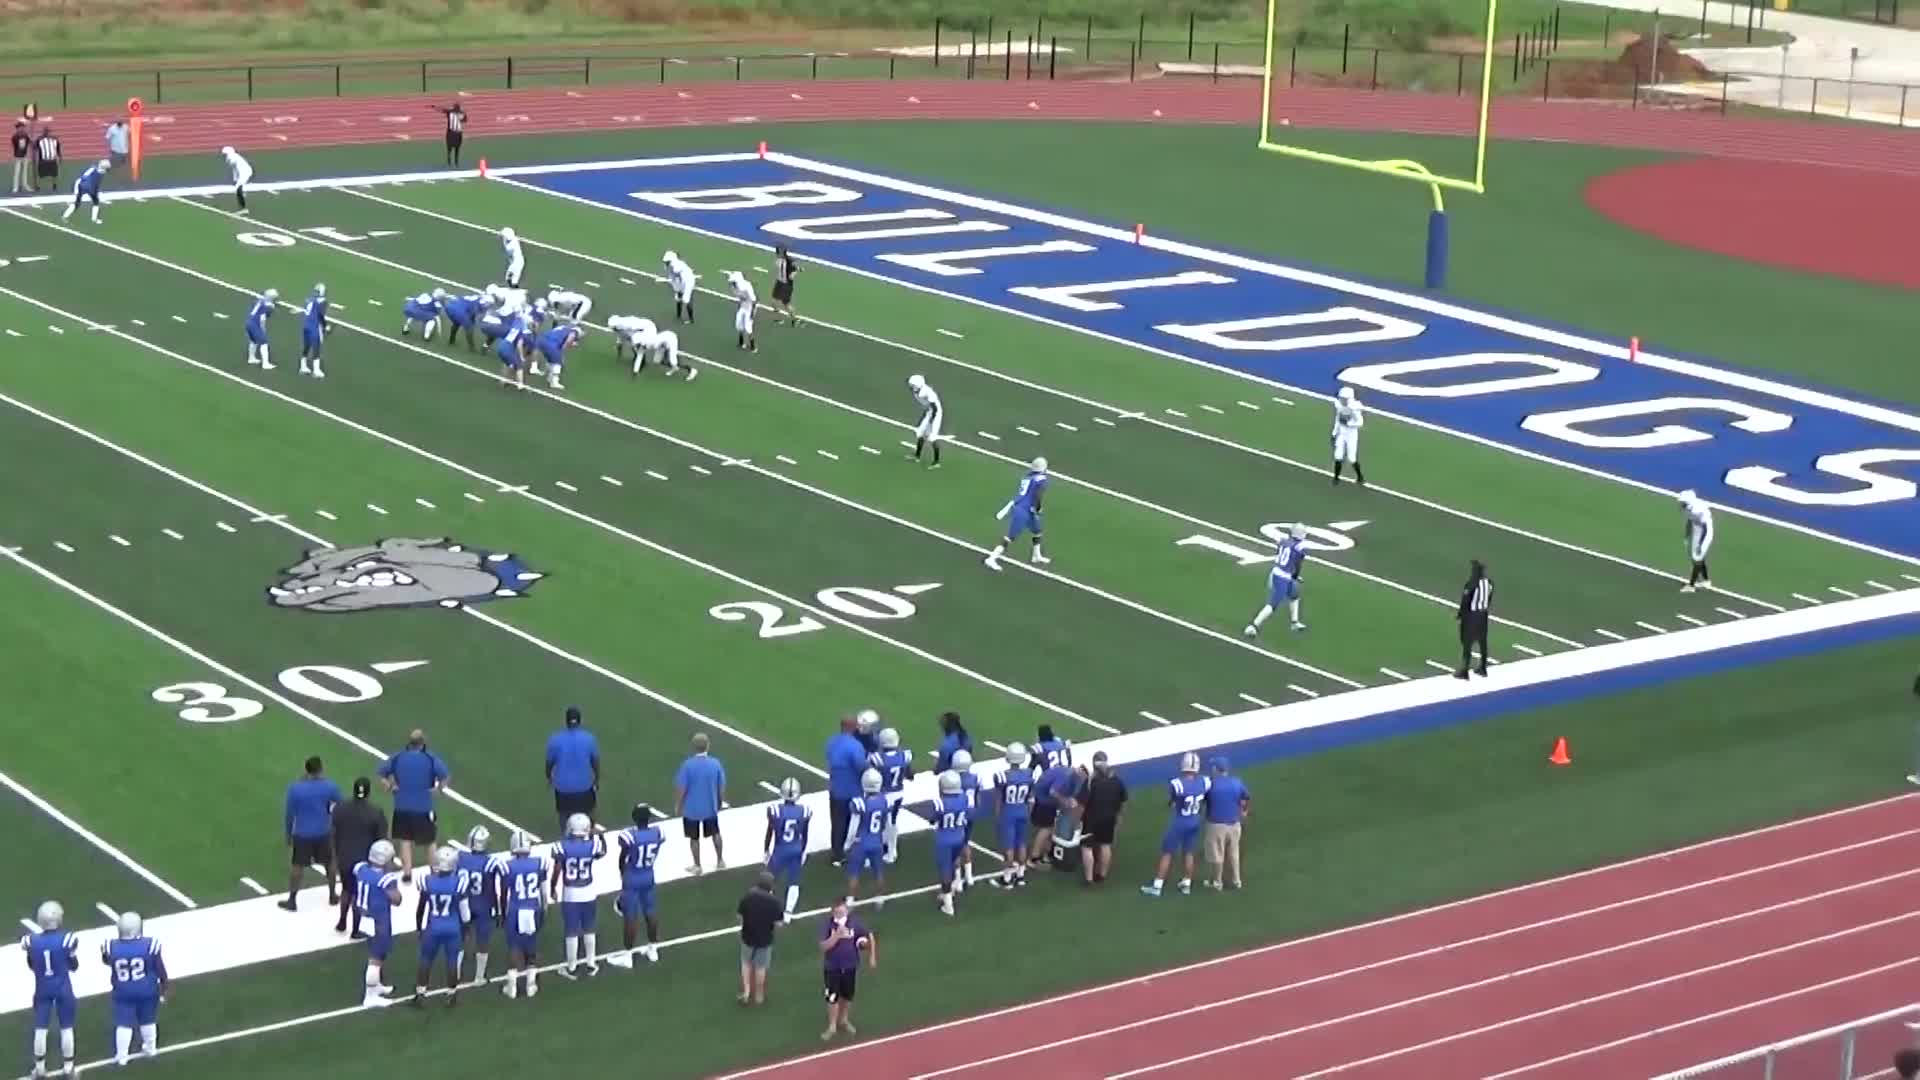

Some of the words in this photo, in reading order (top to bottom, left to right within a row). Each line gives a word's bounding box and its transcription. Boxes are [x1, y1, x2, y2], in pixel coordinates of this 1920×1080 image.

[628, 180, 1920, 506] BULLDOGS
[709, 586, 916, 638] 20
[152, 663, 384, 723] 30
[889, 766, 902, 787] 7
[783, 819, 797, 842] 5
[869, 811, 882, 834] 6
[565, 855, 592, 882] 65
[514, 871, 540, 900] 42
[430, 893, 452, 917] 17
[43, 949, 54, 976] 1
[115, 957, 145, 982] 62
